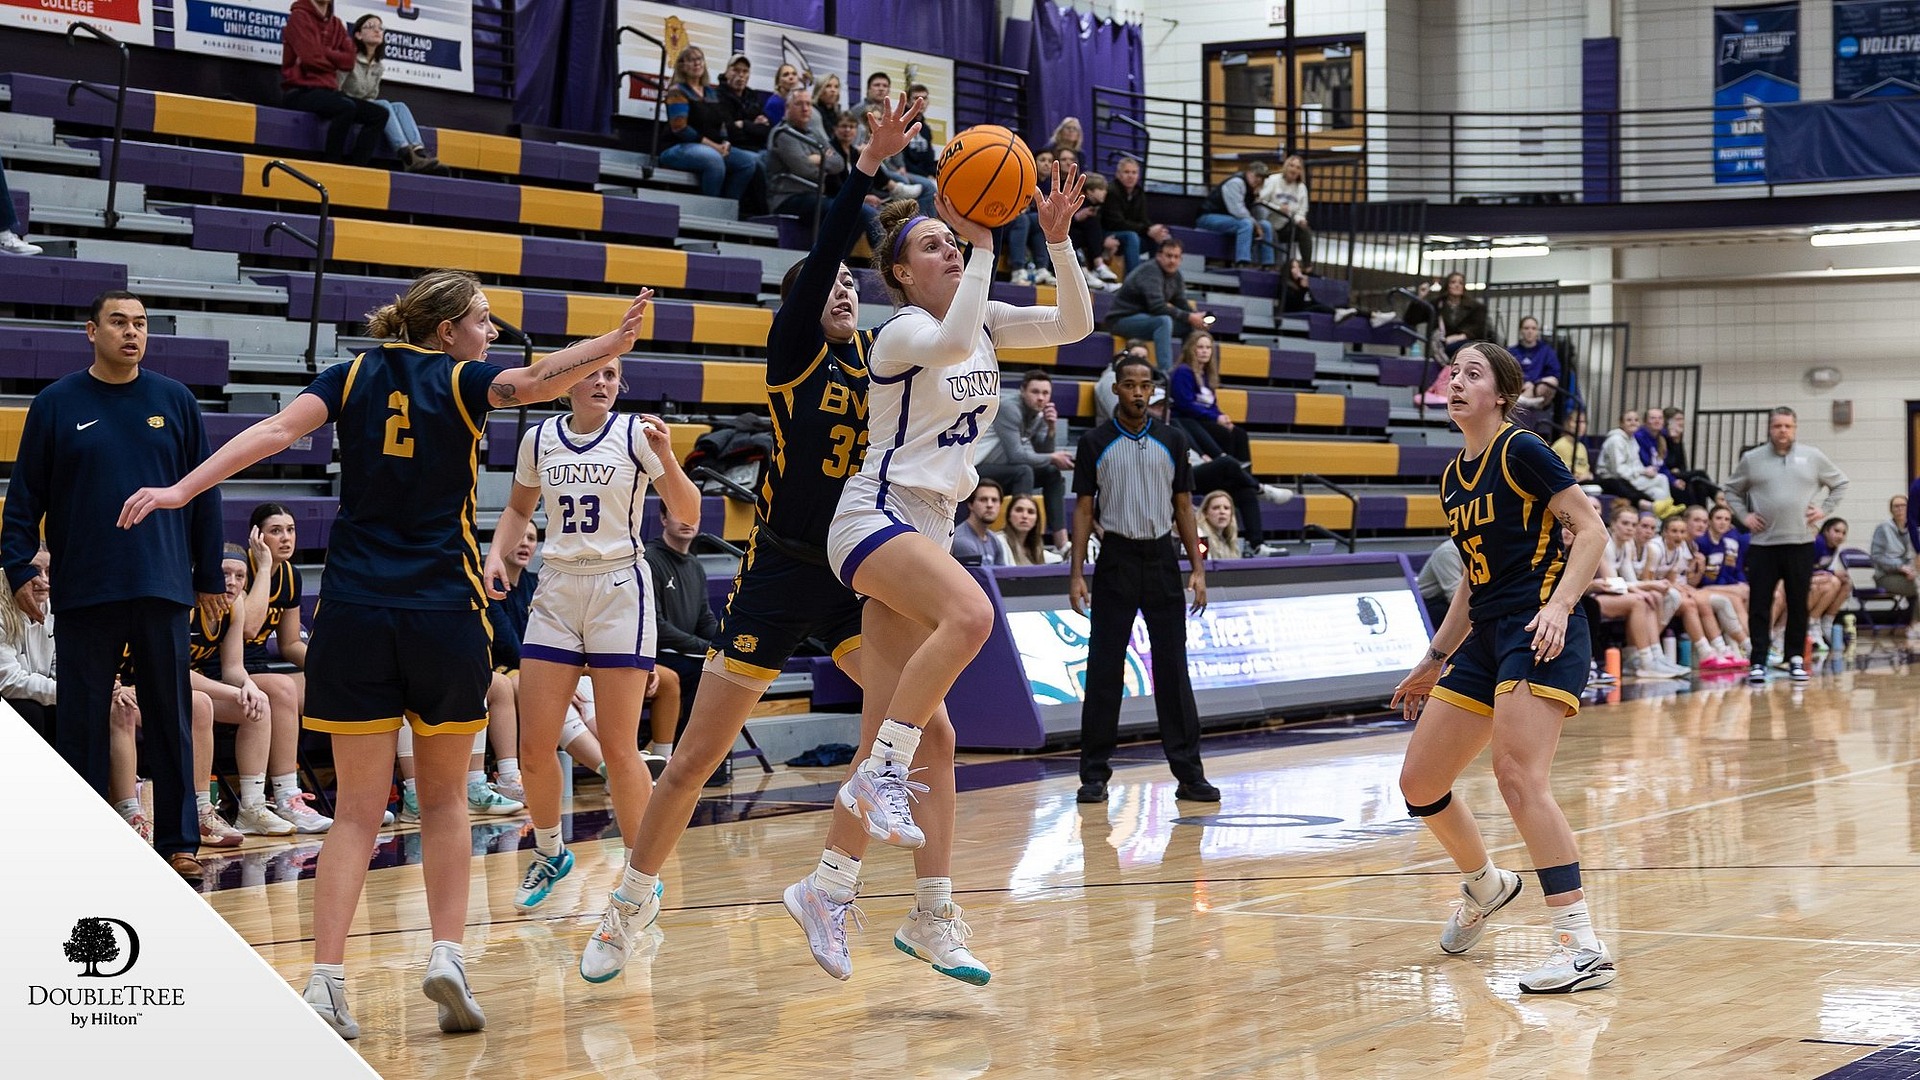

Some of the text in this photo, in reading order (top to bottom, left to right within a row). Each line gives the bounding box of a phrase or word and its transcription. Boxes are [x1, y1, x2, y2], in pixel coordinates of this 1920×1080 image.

[41, 0, 94, 13] COLLEGE
[211, 6, 288, 27] NORTH CENTRA
[223, 21, 281, 40] UNIVERSITY
[384, 32, 432, 50] ORTHLAND
[384, 45, 426, 62] COLLEGE
[1861, 34, 1920, 54] VOLLEYB
[1731, 120, 1764, 135] UN
[946, 370, 998, 401] UNW
[819, 379, 869, 420] BV
[383, 391, 415, 458] 2
[547, 463, 616, 486] UNW
[558, 494, 600, 534] 23
[1449, 493, 1496, 537] BVU
[1462, 534, 1491, 586] 15
[1203, 611, 1250, 648] Tree
